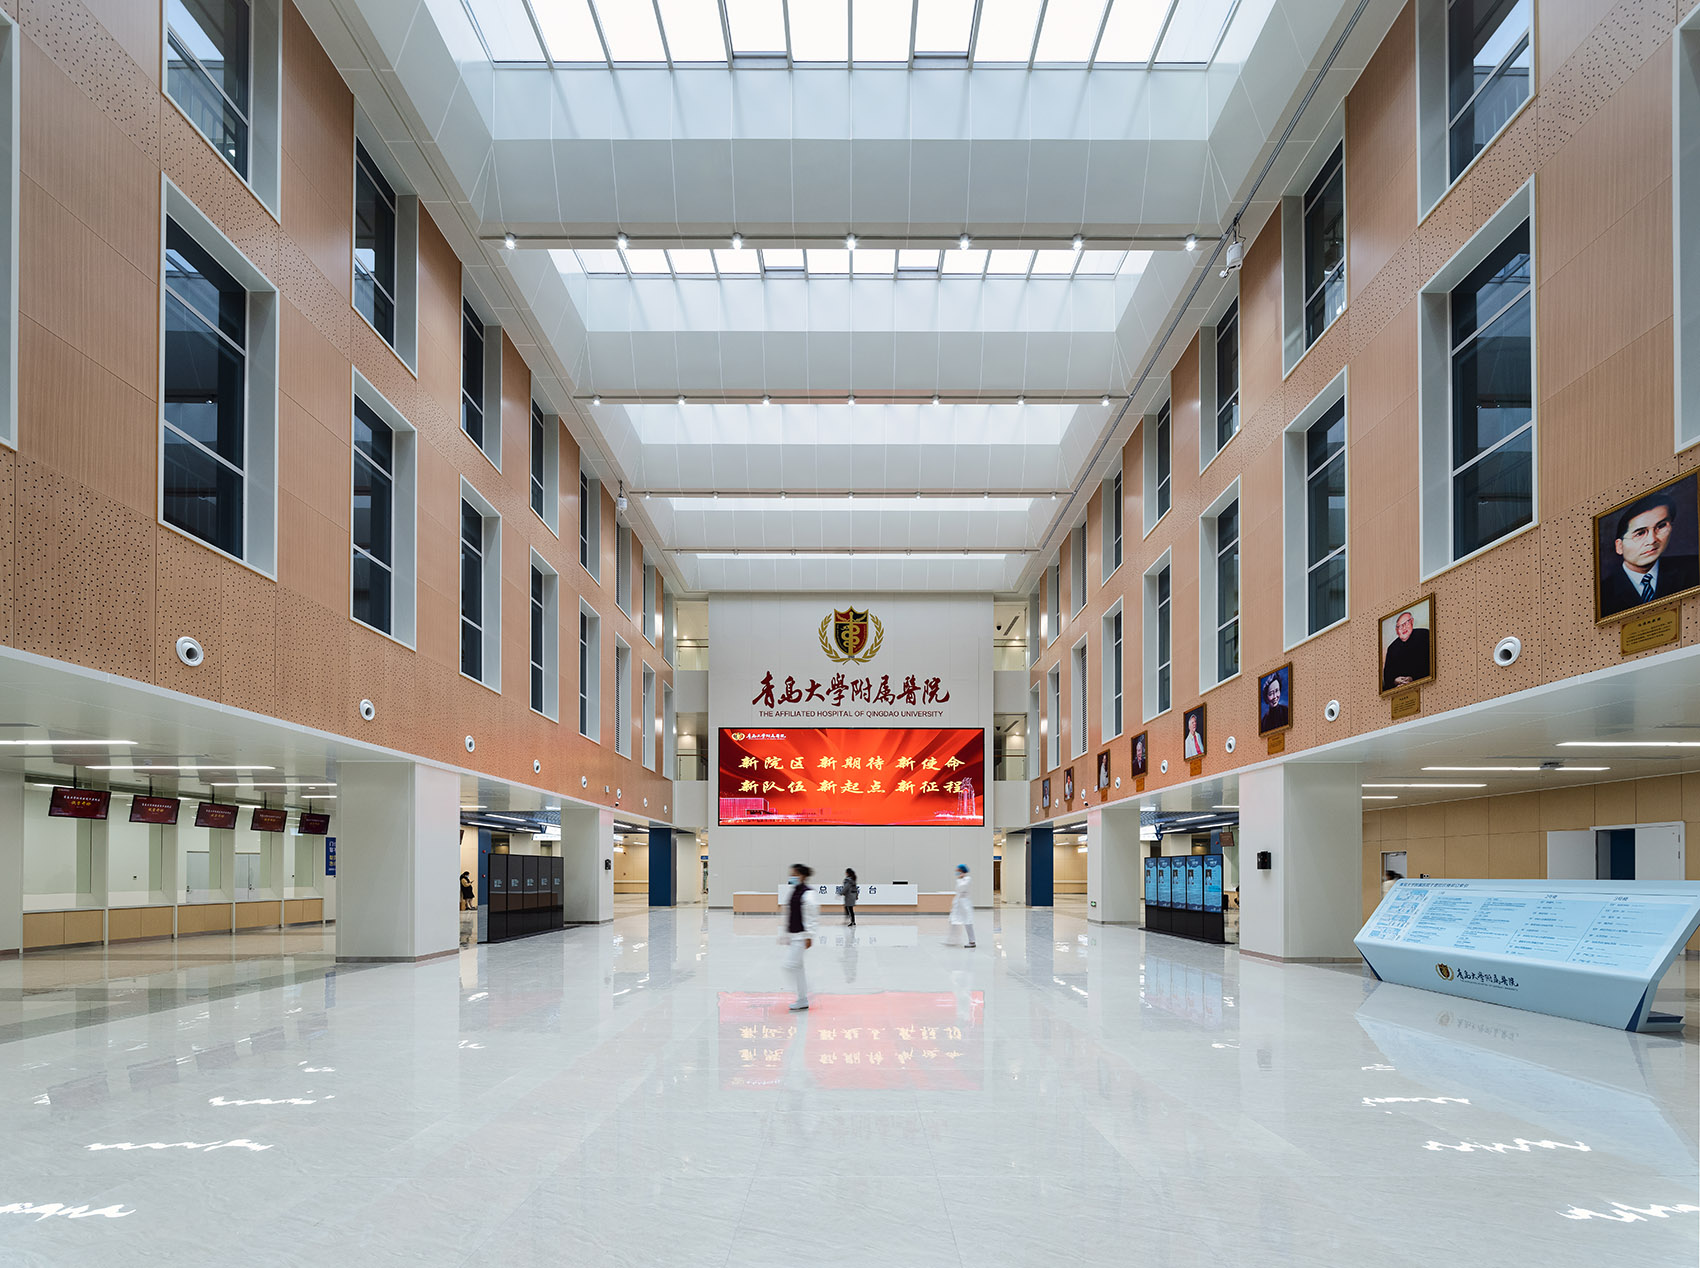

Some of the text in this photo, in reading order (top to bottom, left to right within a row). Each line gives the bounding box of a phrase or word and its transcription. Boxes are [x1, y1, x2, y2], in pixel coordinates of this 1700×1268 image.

[759, 710, 943, 719] THE AFFILIATED HOSPITAL OF QINGDAO UNIVERSITY
[738, 756, 966, 771] 新院区 新期待 新使命
[738, 780, 964, 794] 新队伍 新起点 新征程
[819, 885, 877, 895] 总服台
